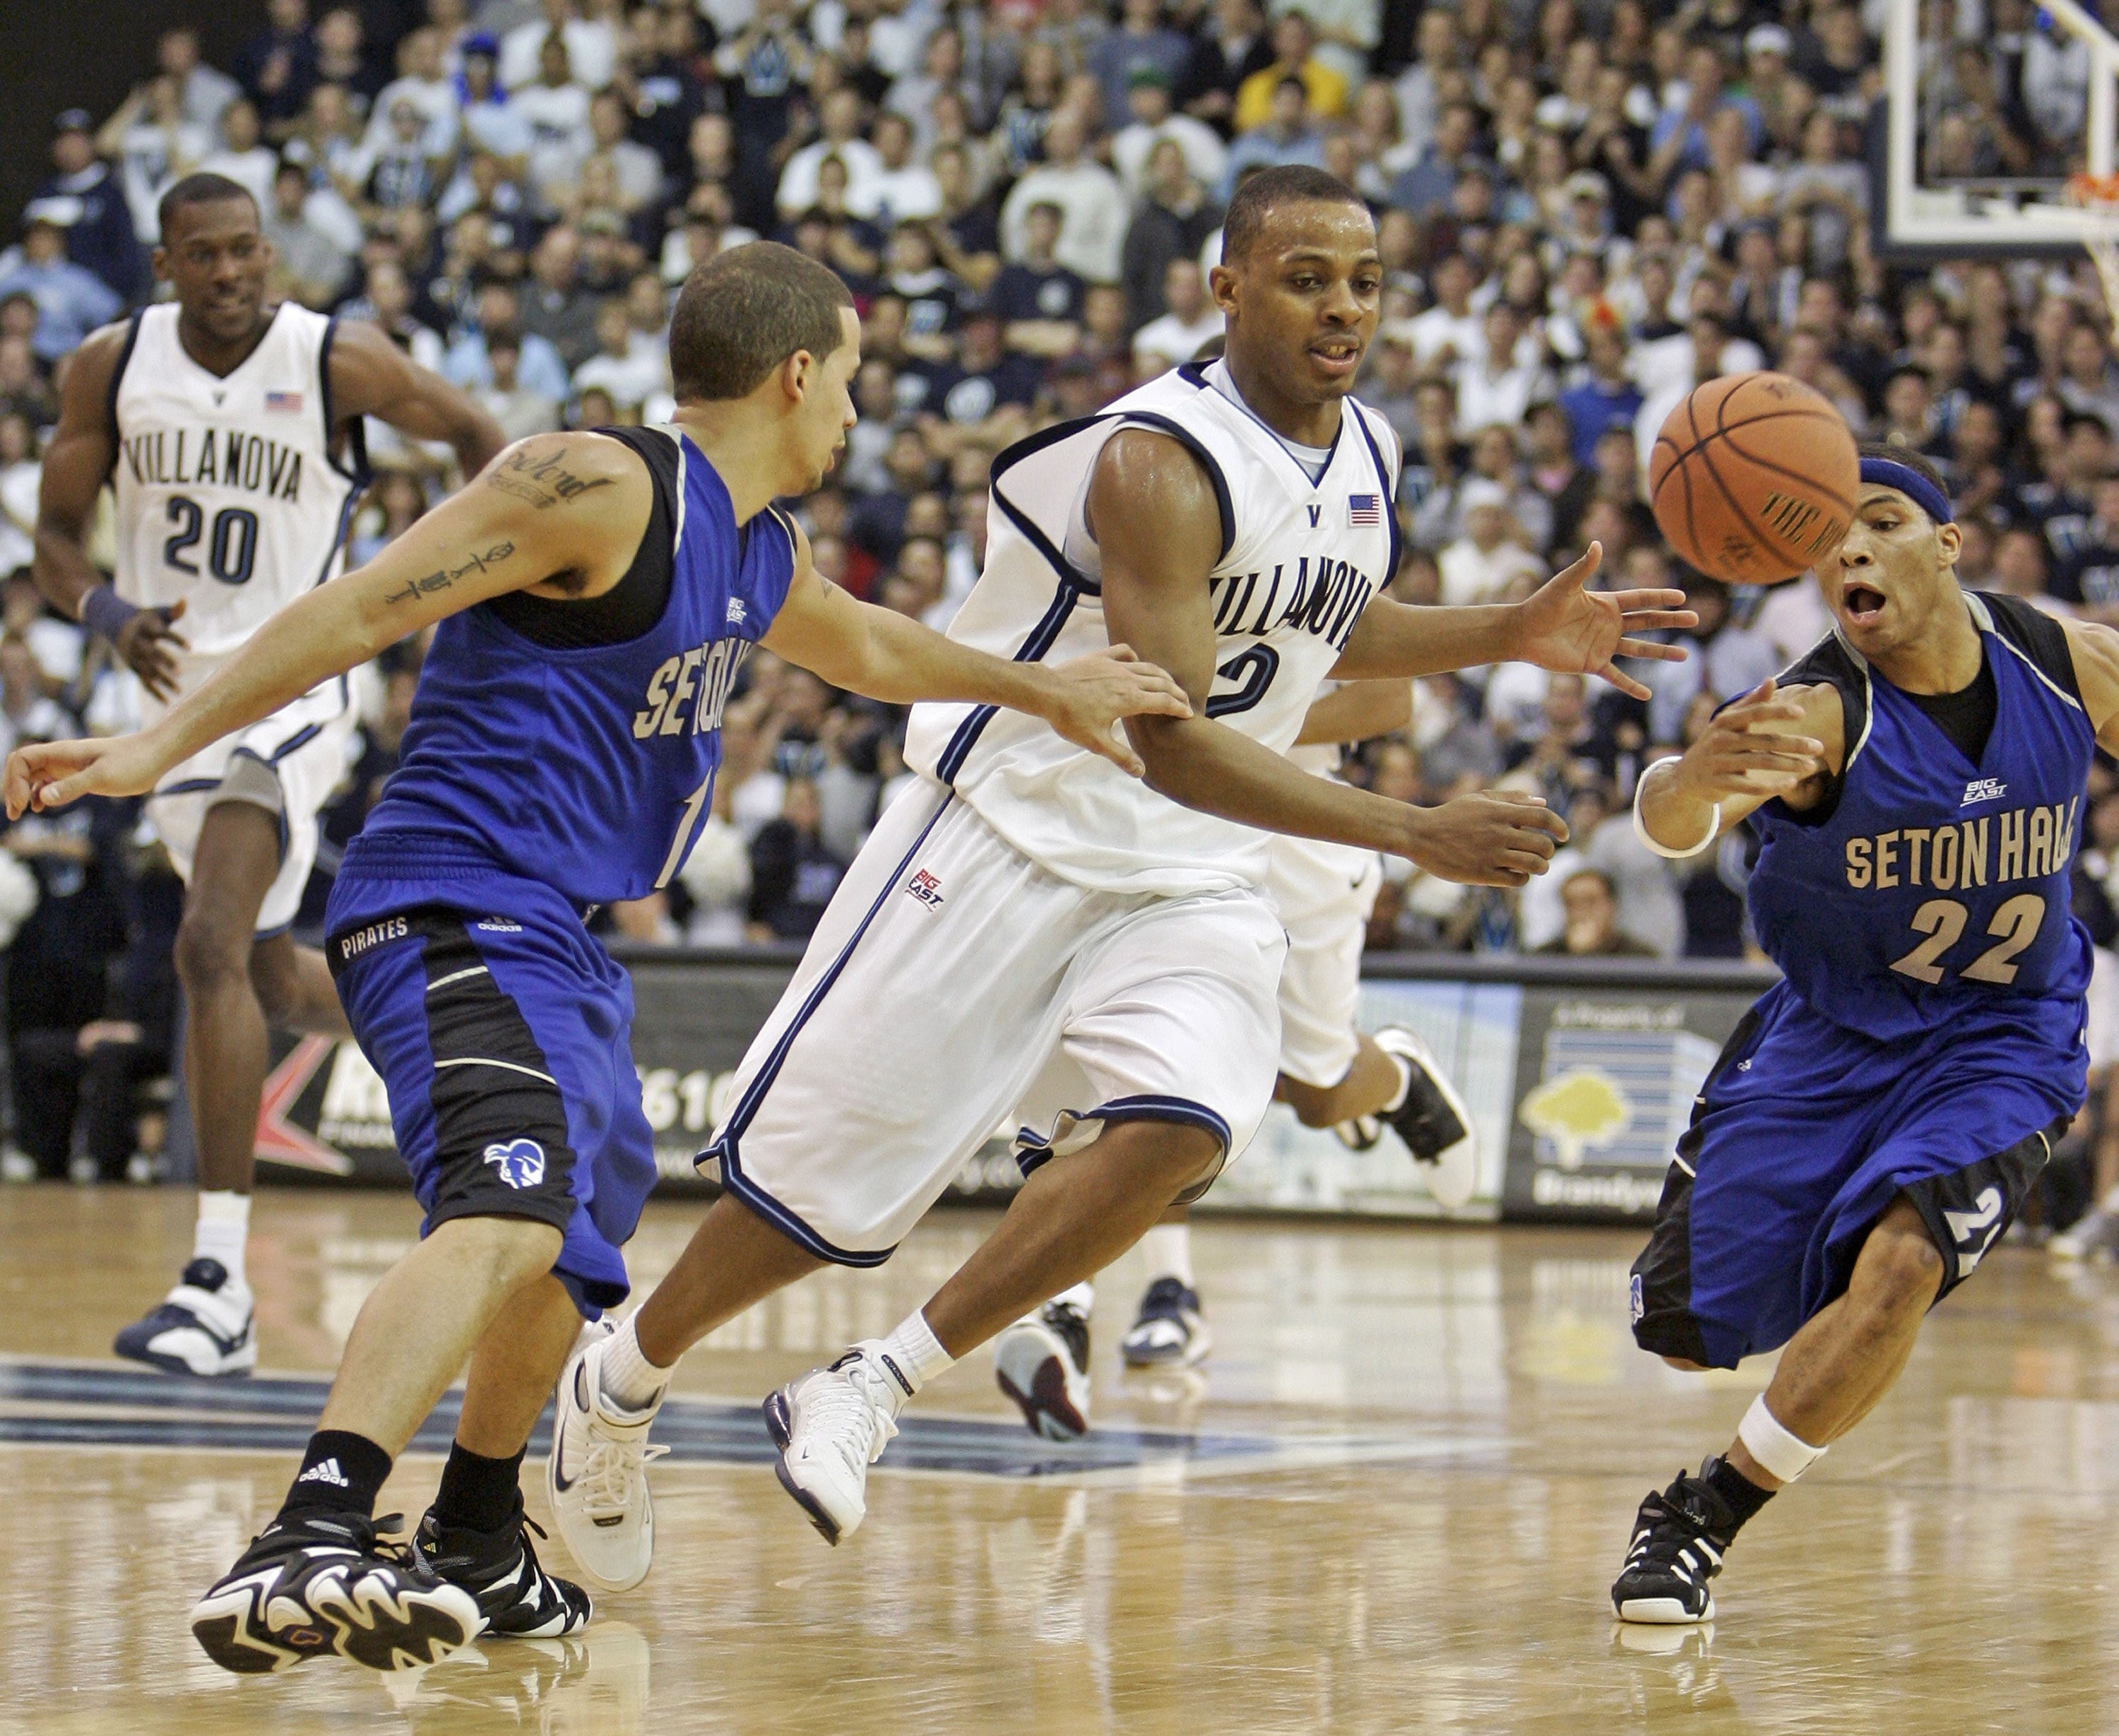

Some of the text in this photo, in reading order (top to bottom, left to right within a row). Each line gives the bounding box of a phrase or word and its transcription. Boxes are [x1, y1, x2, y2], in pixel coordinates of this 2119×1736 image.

[123, 429, 302, 503] VILLANOVA
[164, 494, 259, 585] 20
[1306, 504, 1322, 528] V
[1204, 643, 1280, 719] 2
[1963, 784, 2007, 802] EAST
[1966, 778, 1998, 792] BIG
[654, 766, 713, 889] 1
[1846, 818, 1990, 891] SETON
[915, 868, 942, 890] BIG
[341, 917, 408, 960] PIRATES
[1888, 893, 2046, 985] 22
[299, 1473, 348, 1487] adidas
